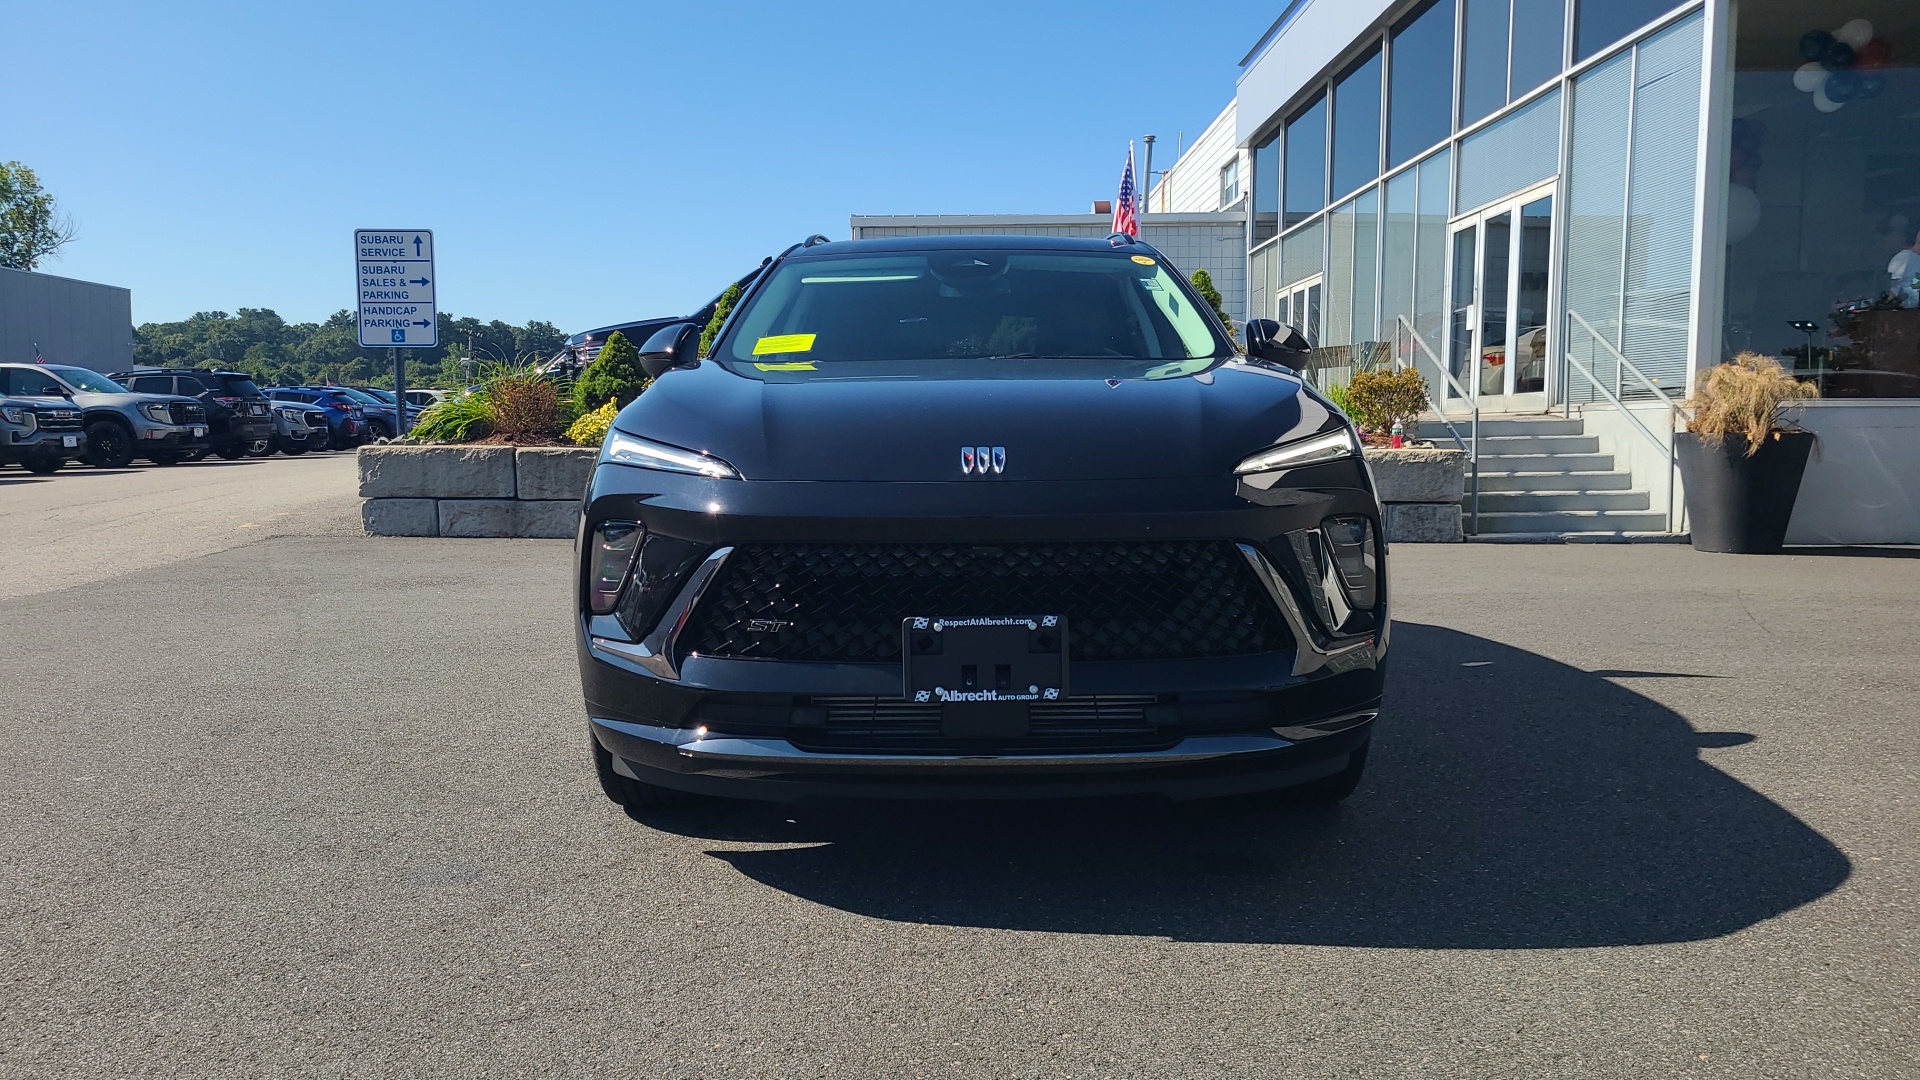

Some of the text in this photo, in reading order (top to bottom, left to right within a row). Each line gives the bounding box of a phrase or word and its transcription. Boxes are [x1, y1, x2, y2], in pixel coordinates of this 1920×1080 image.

[360, 235, 404, 245] SUBARU
[361, 248, 406, 257] SERVICE
[361, 265, 405, 275] SUBARU
[362, 278, 407, 287] SALES &
[363, 290, 409, 300] PARKING
[363, 306, 417, 315] HANDICAP
[364, 319, 410, 328] PARKING
[747, 619, 787, 632] ST
[939, 617, 1032, 628] RespectAtAlbrecht.com
[940, 689, 997, 702] Albrecht
